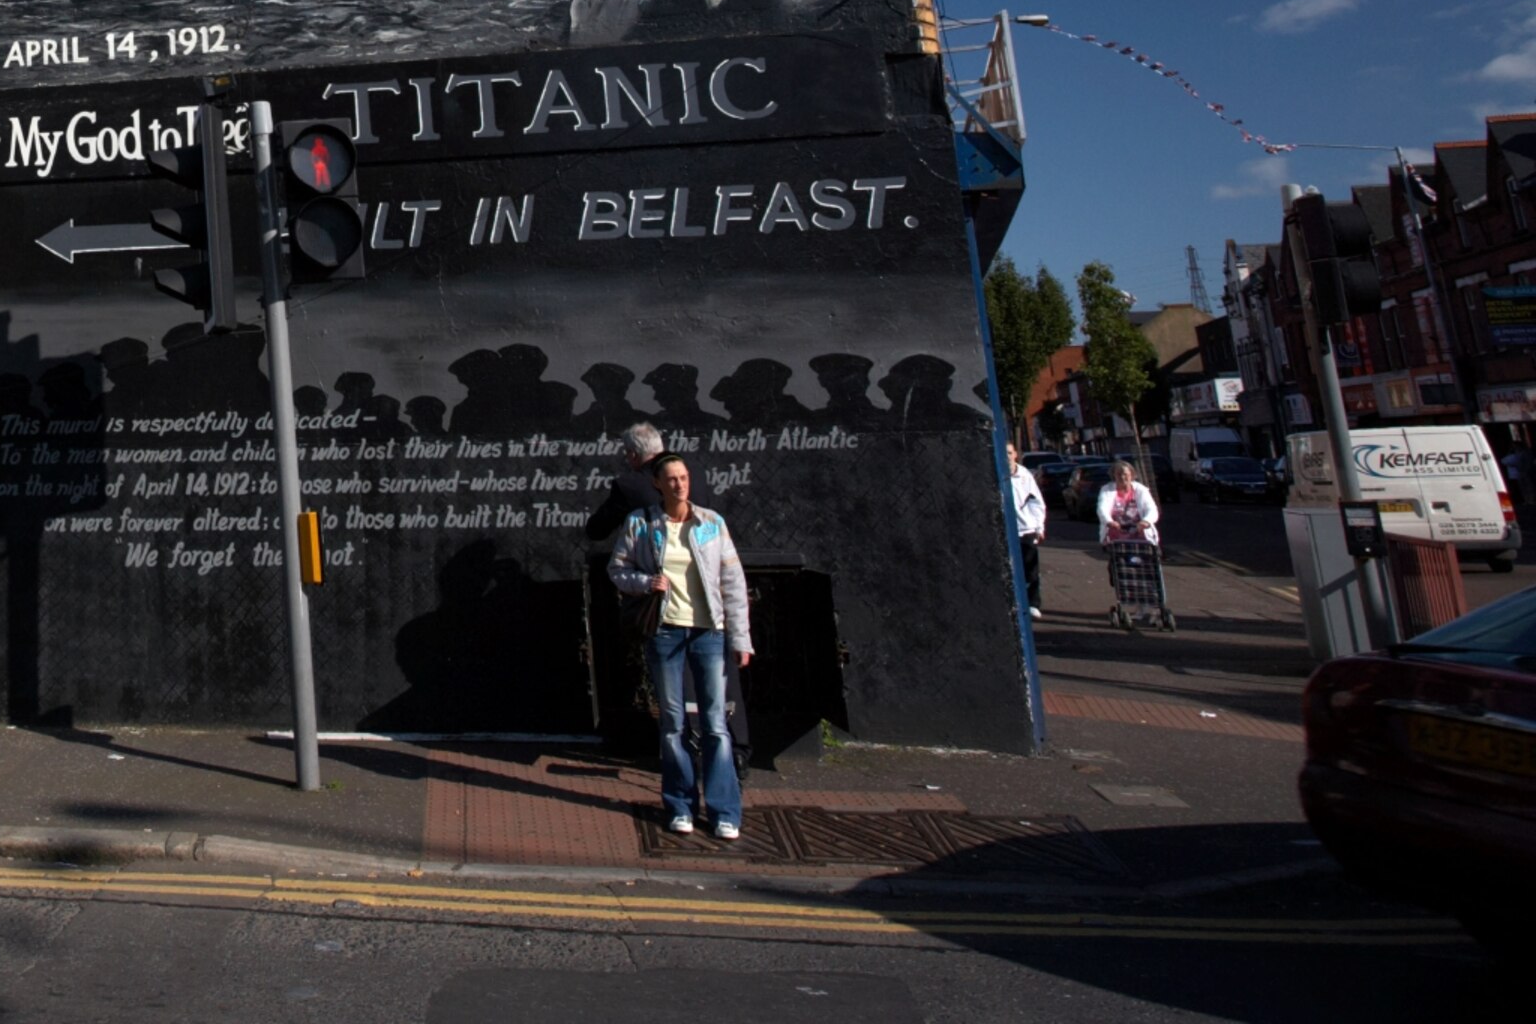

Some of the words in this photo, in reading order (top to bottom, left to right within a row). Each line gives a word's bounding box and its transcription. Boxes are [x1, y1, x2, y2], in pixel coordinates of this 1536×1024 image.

[3, 36, 89, 68] APRIL
[322, 56, 779, 145] TITANIC
[5, 116, 64, 177] My
[66, 109, 144, 165] God
[148, 119, 183, 152] to
[469, 194, 534, 246] IN
[578, 176, 921, 242] BELFAST.
[1, 414, 40, 436] This
[46, 415, 103, 434] mural
[106, 417, 124, 433] is
[131, 411, 249, 438] respectfully
[0, 443, 22, 465] To
[32, 442, 59, 465] the
[67, 447, 109, 464] men
[311, 438, 350, 460] who
[357, 437, 395, 460] lost
[404, 436, 452, 459] their
[457, 435, 502, 459] lives
[508, 437, 524, 458] in
[529, 433, 560, 457] the
[669, 428, 700, 452] the
[709, 428, 767, 452] North
[777, 426, 859, 450] Atlantic
[1380, 451, 1474, 469] KEMFAST
[25, 476, 52, 495] the
[56, 477, 102, 504] night
[105, 473, 124, 499] of
[132, 473, 179, 499] April
[259, 472, 278, 495] to
[335, 471, 372, 494] who
[531, 467, 578, 492] lives
[70, 516, 112, 532] were
[118, 507, 183, 533] forever
[346, 504, 396, 529] those
[400, 505, 446, 528] who
[450, 504, 493, 528] built
[495, 503, 526, 527] the
[168, 542, 235, 575] forget
